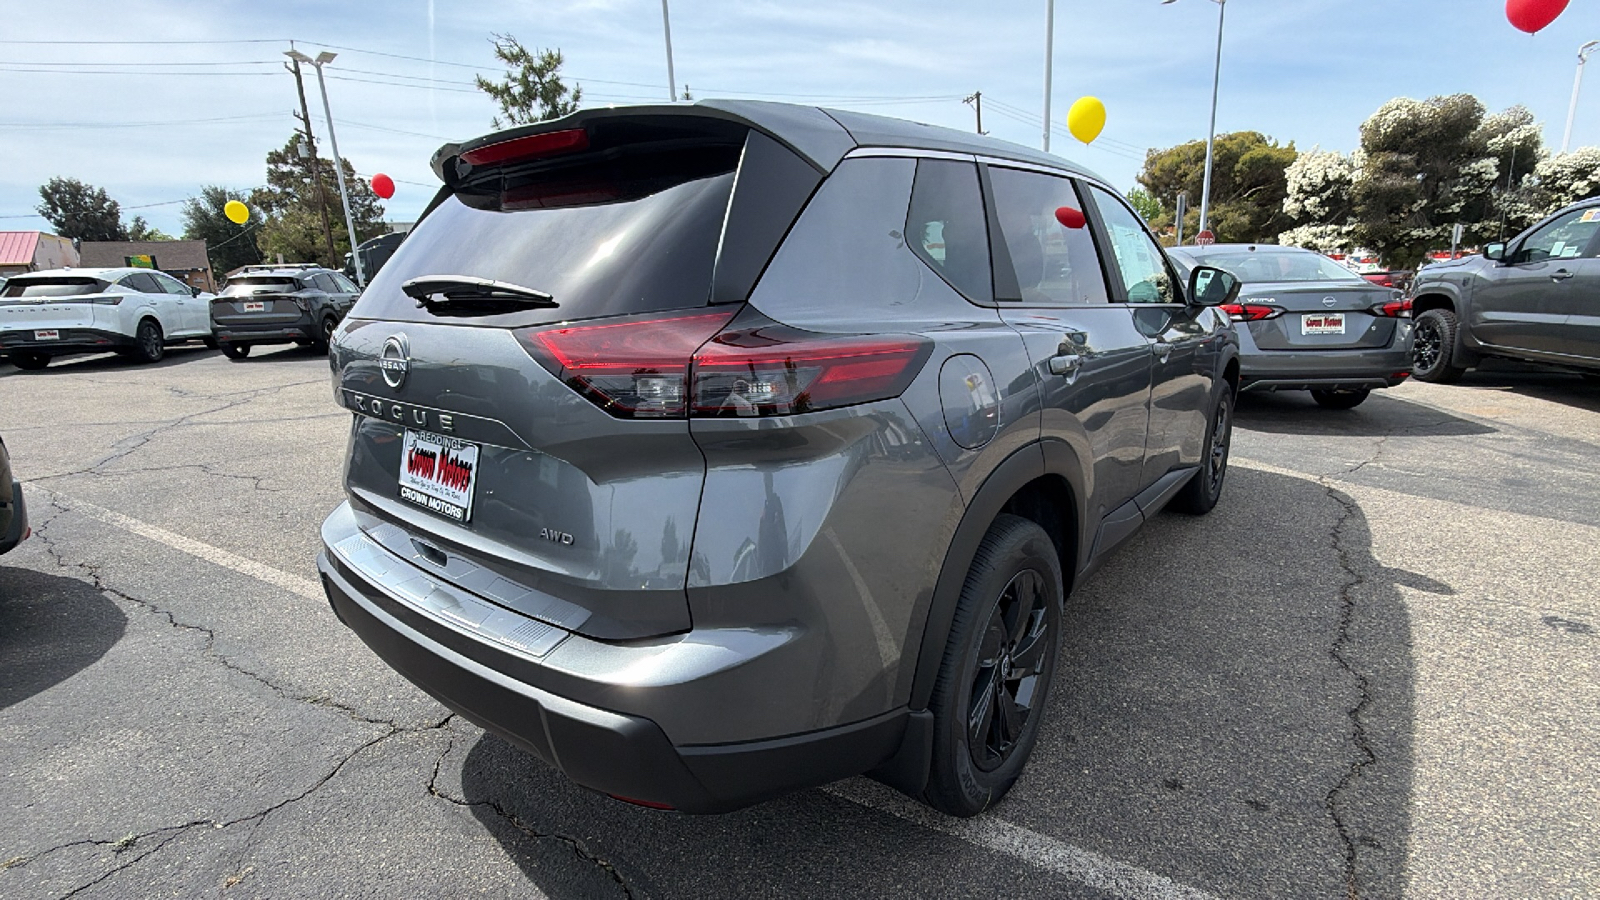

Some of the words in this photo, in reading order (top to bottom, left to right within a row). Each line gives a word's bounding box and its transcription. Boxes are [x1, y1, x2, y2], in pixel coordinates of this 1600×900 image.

[1196, 237, 1213, 246] STOP
[354, 394, 456, 432] ROGUE
[419, 431, 459, 449] REDDING
[407, 442, 437, 480] Crown
[436, 446, 473, 493] Motors
[401, 486, 428, 506] CROWN
[428, 496, 462, 519] MOTORS
[540, 527, 575, 545] AWD
